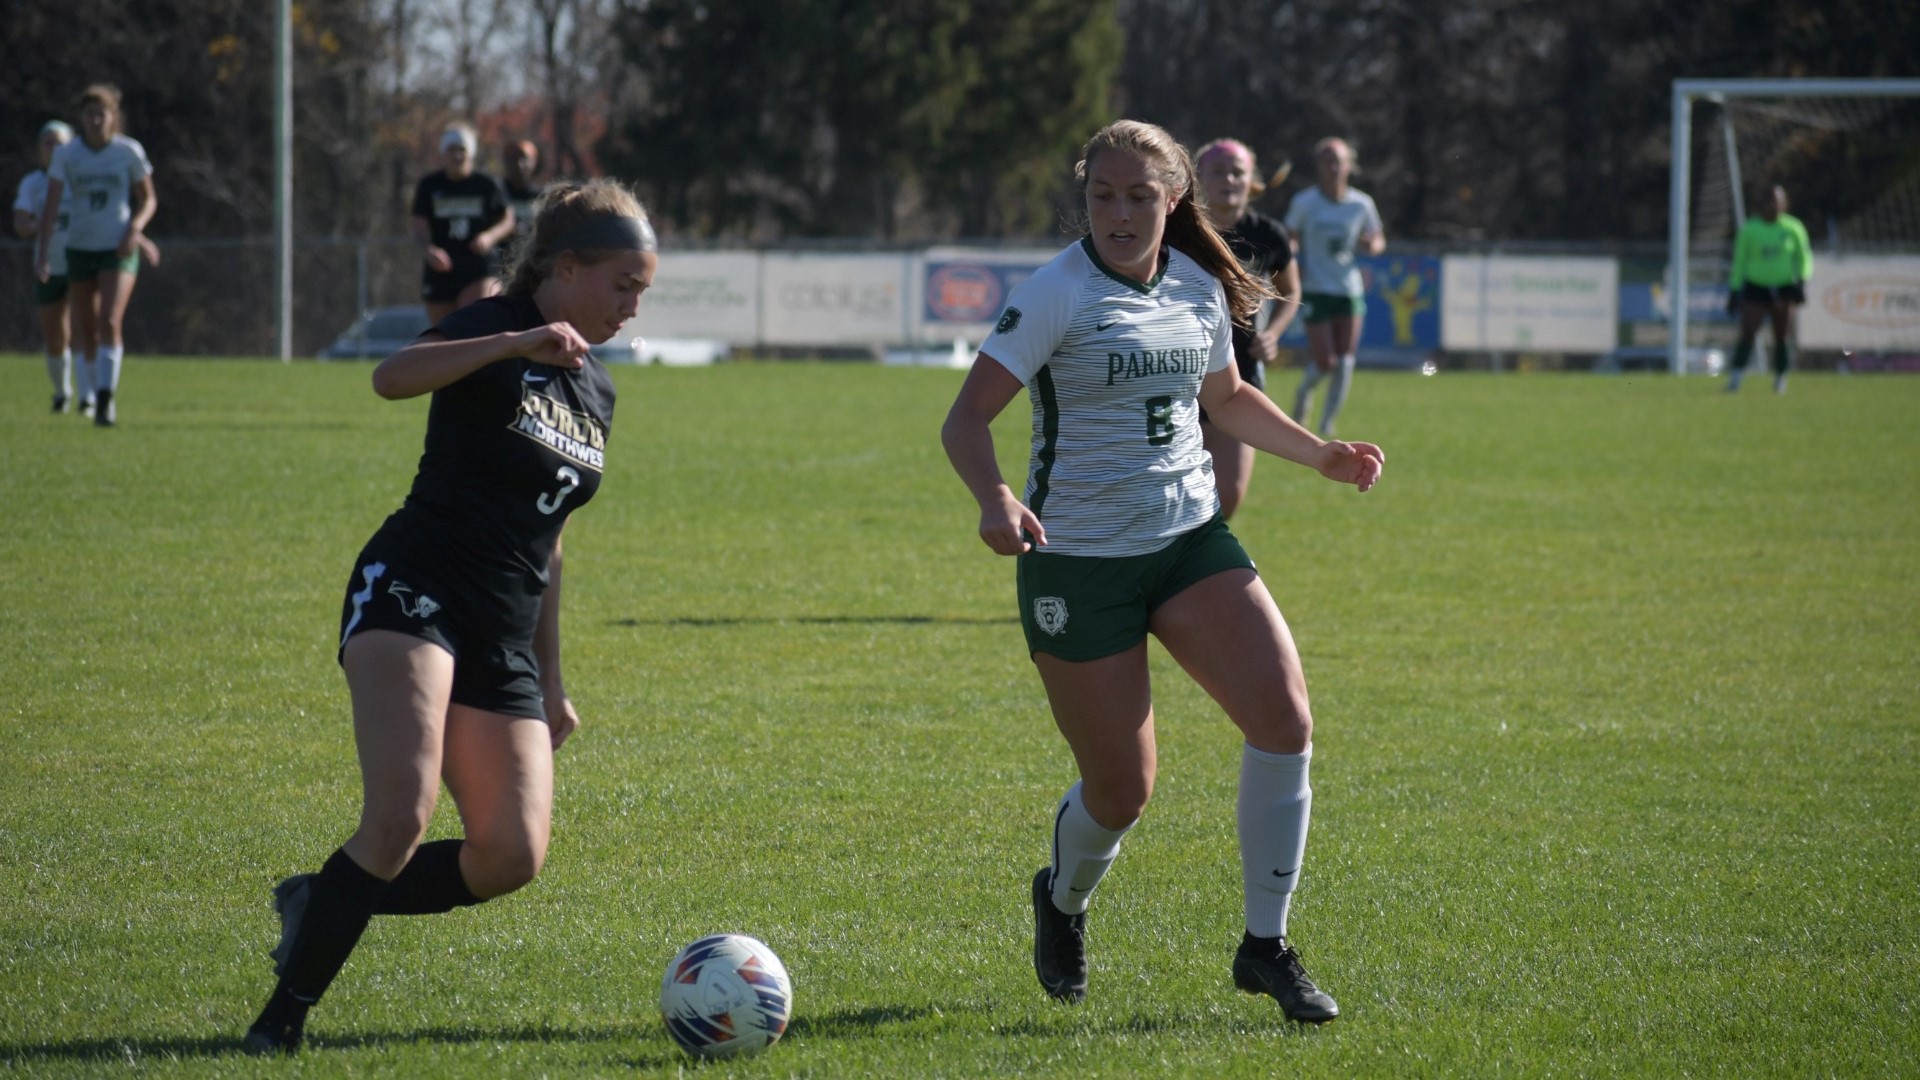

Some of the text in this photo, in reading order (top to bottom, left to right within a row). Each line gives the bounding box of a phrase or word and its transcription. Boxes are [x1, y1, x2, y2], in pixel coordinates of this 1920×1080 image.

[518, 414, 604, 468] NORTHWES
[521, 395, 605, 450] PURDU
[1145, 396, 1175, 446] 8
[536, 466, 580, 515] 3
